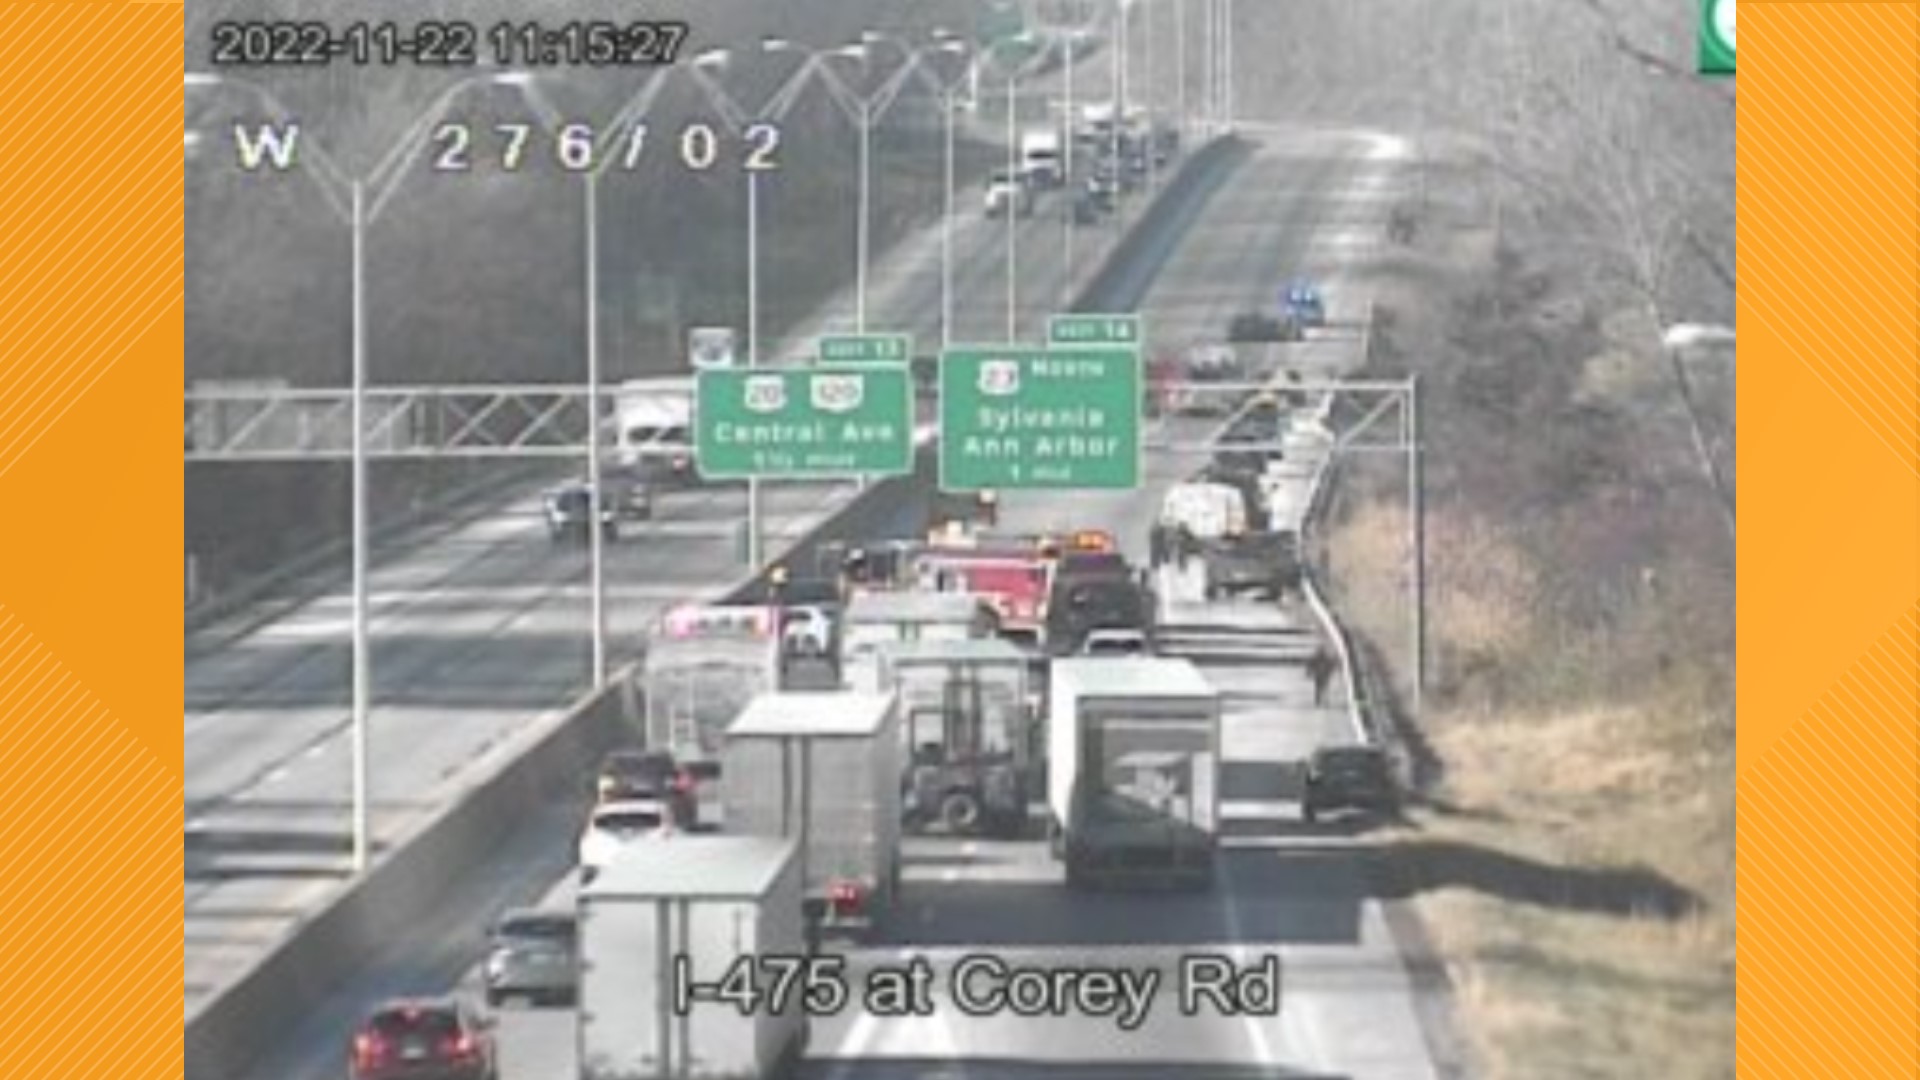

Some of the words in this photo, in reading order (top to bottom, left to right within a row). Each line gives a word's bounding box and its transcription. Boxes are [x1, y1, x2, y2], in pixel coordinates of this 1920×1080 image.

[1105, 322, 1130, 338] 14
[977, 406, 1105, 433] Sylvania
[714, 420, 827, 444] Central
[843, 421, 894, 443] Ave
[962, 435, 1020, 456] Ann
[1035, 435, 1119, 457] Arbor
